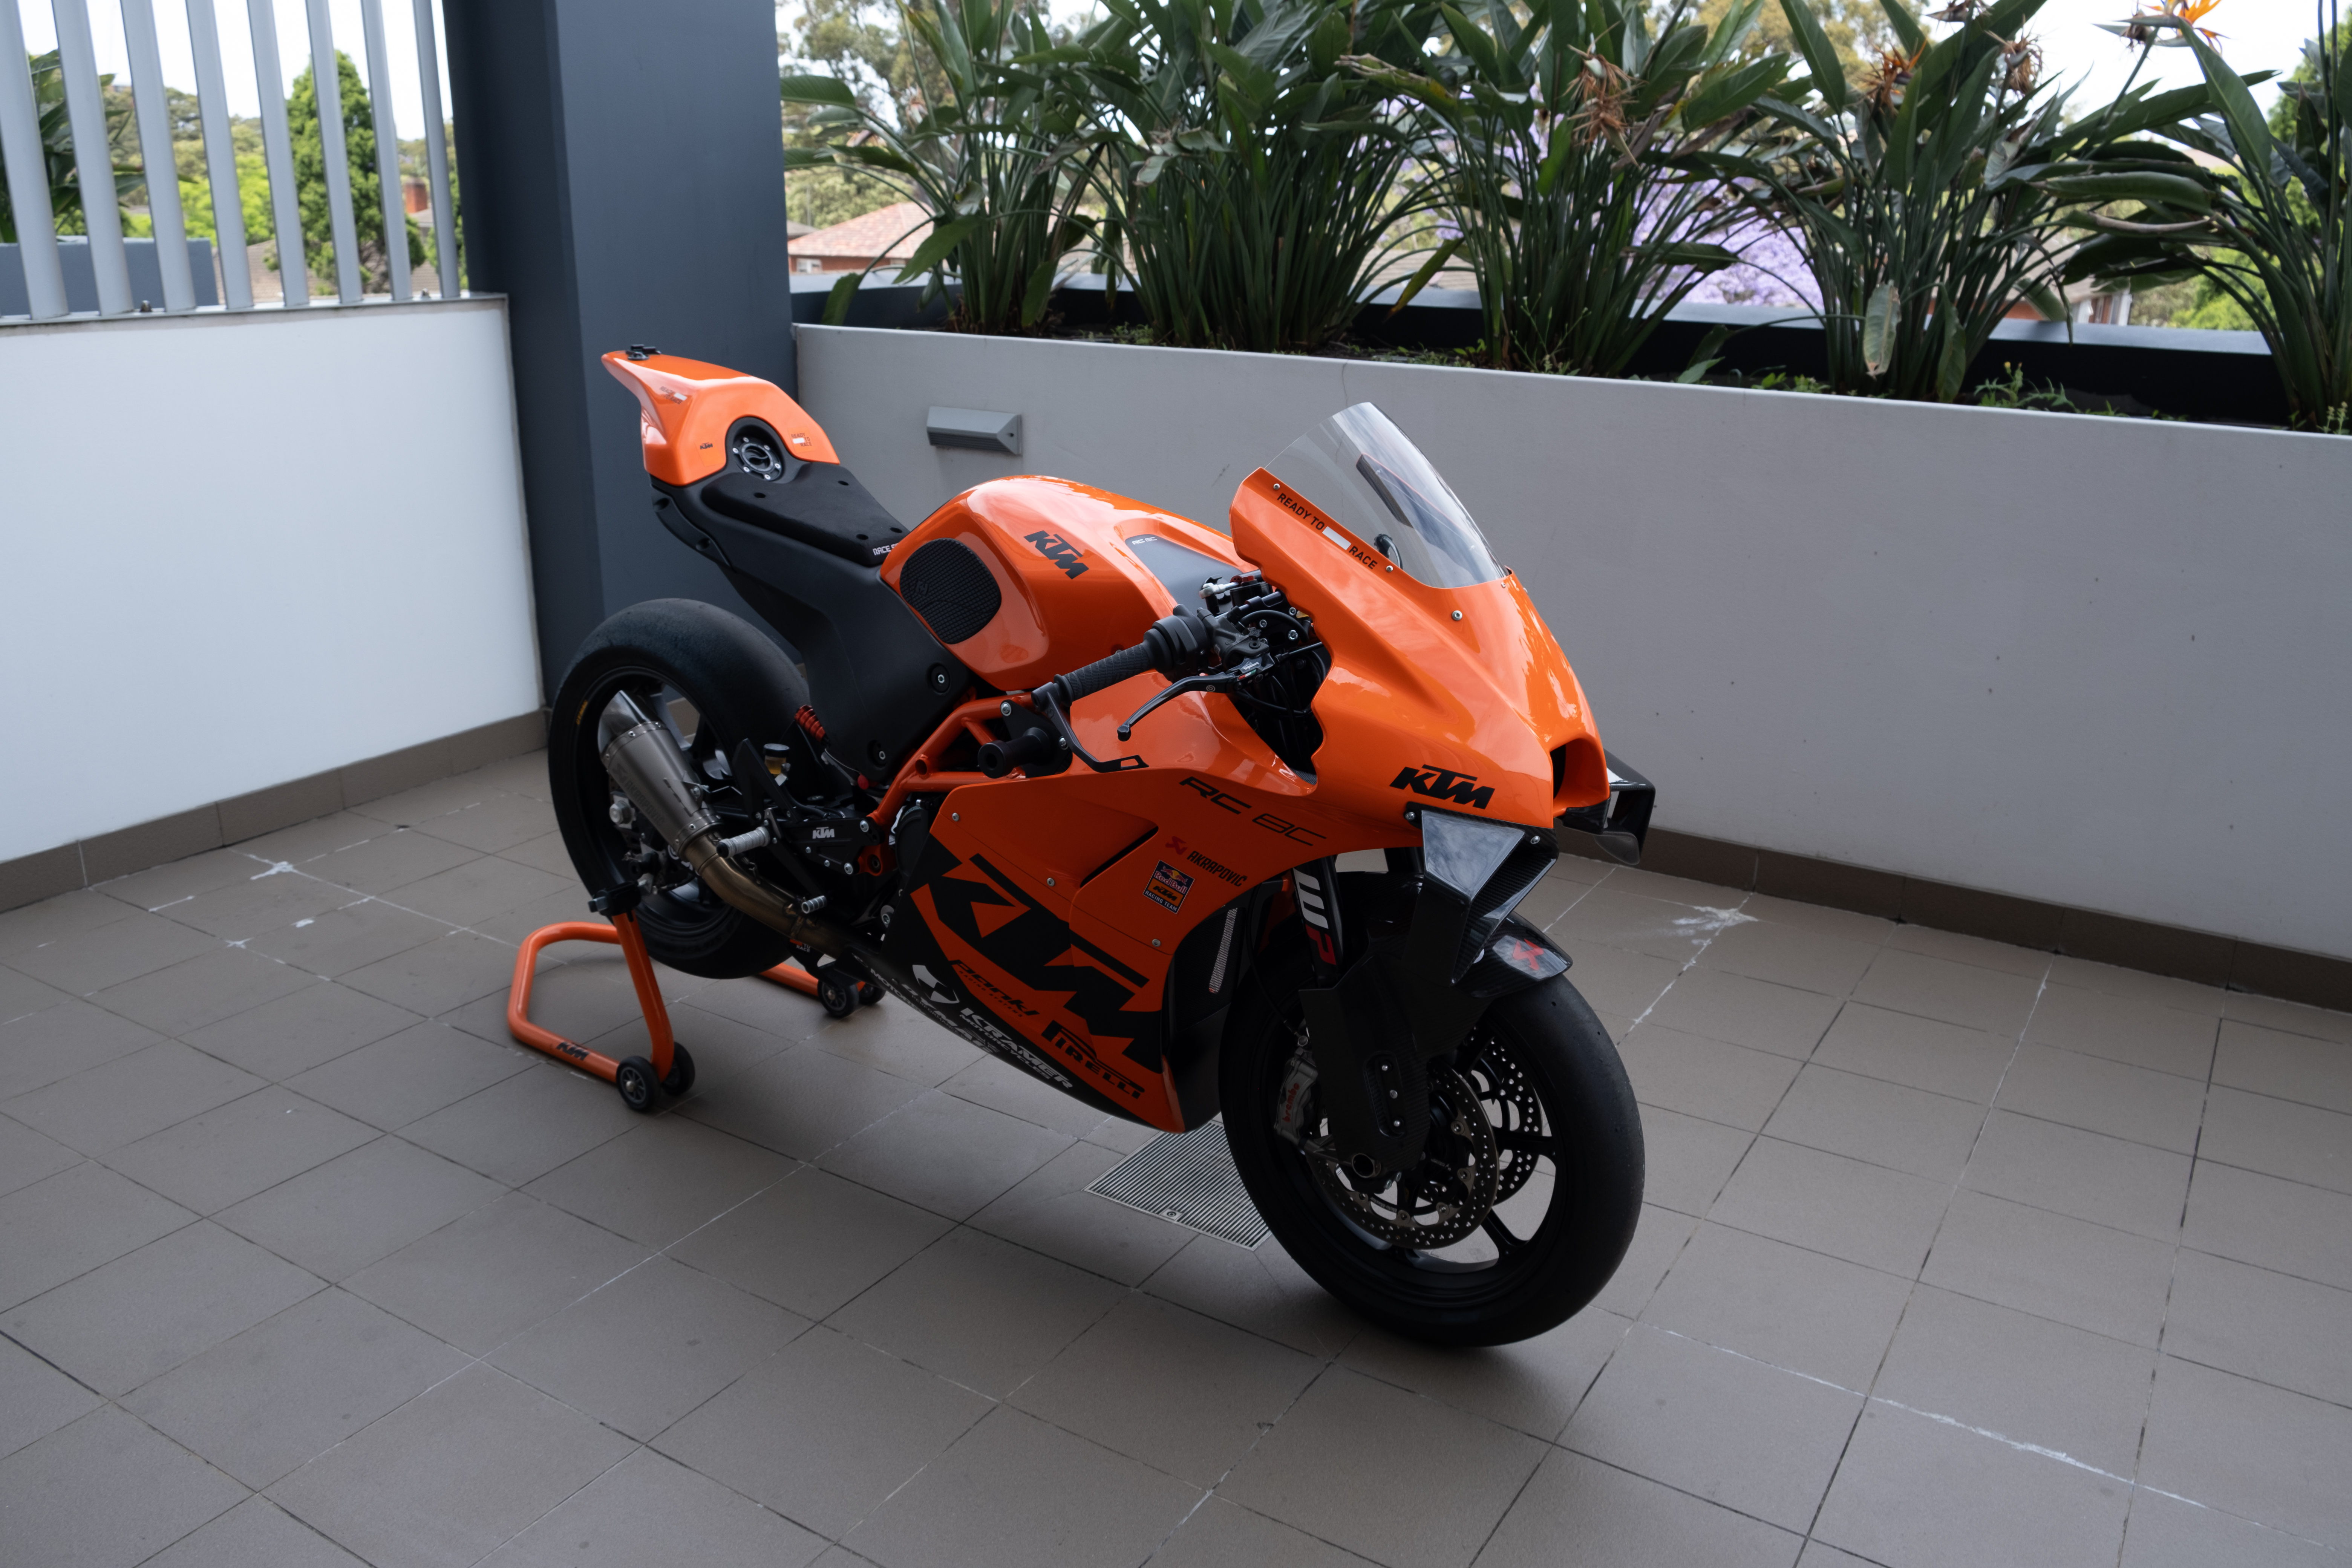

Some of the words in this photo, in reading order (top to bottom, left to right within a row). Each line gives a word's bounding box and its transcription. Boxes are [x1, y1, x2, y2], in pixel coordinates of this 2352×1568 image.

[873, 545, 891, 556] RACE
[1277, 493, 1312, 519] READY
[1311, 516, 1325, 530] TO
[1349, 546, 1378, 570] RACE
[1023, 530, 1089, 579] KTM
[1179, 776, 1252, 814] RC
[1390, 764, 1495, 809] KTM
[812, 827, 835, 839] KTM
[1145, 890, 1163, 903] RACING
[1164, 901, 1177, 912] TEAM
[1153, 886, 1177, 901] KTM
[906, 832, 1163, 1074] KTM
[959, 970, 986, 991] RACING
[556, 1042, 590, 1061] KTM
[959, 1014, 1051, 1080] MOTORCYCLES
[1041, 1020, 1145, 1099] PIRELLI
[1283, 1083, 1300, 1122] brembo
